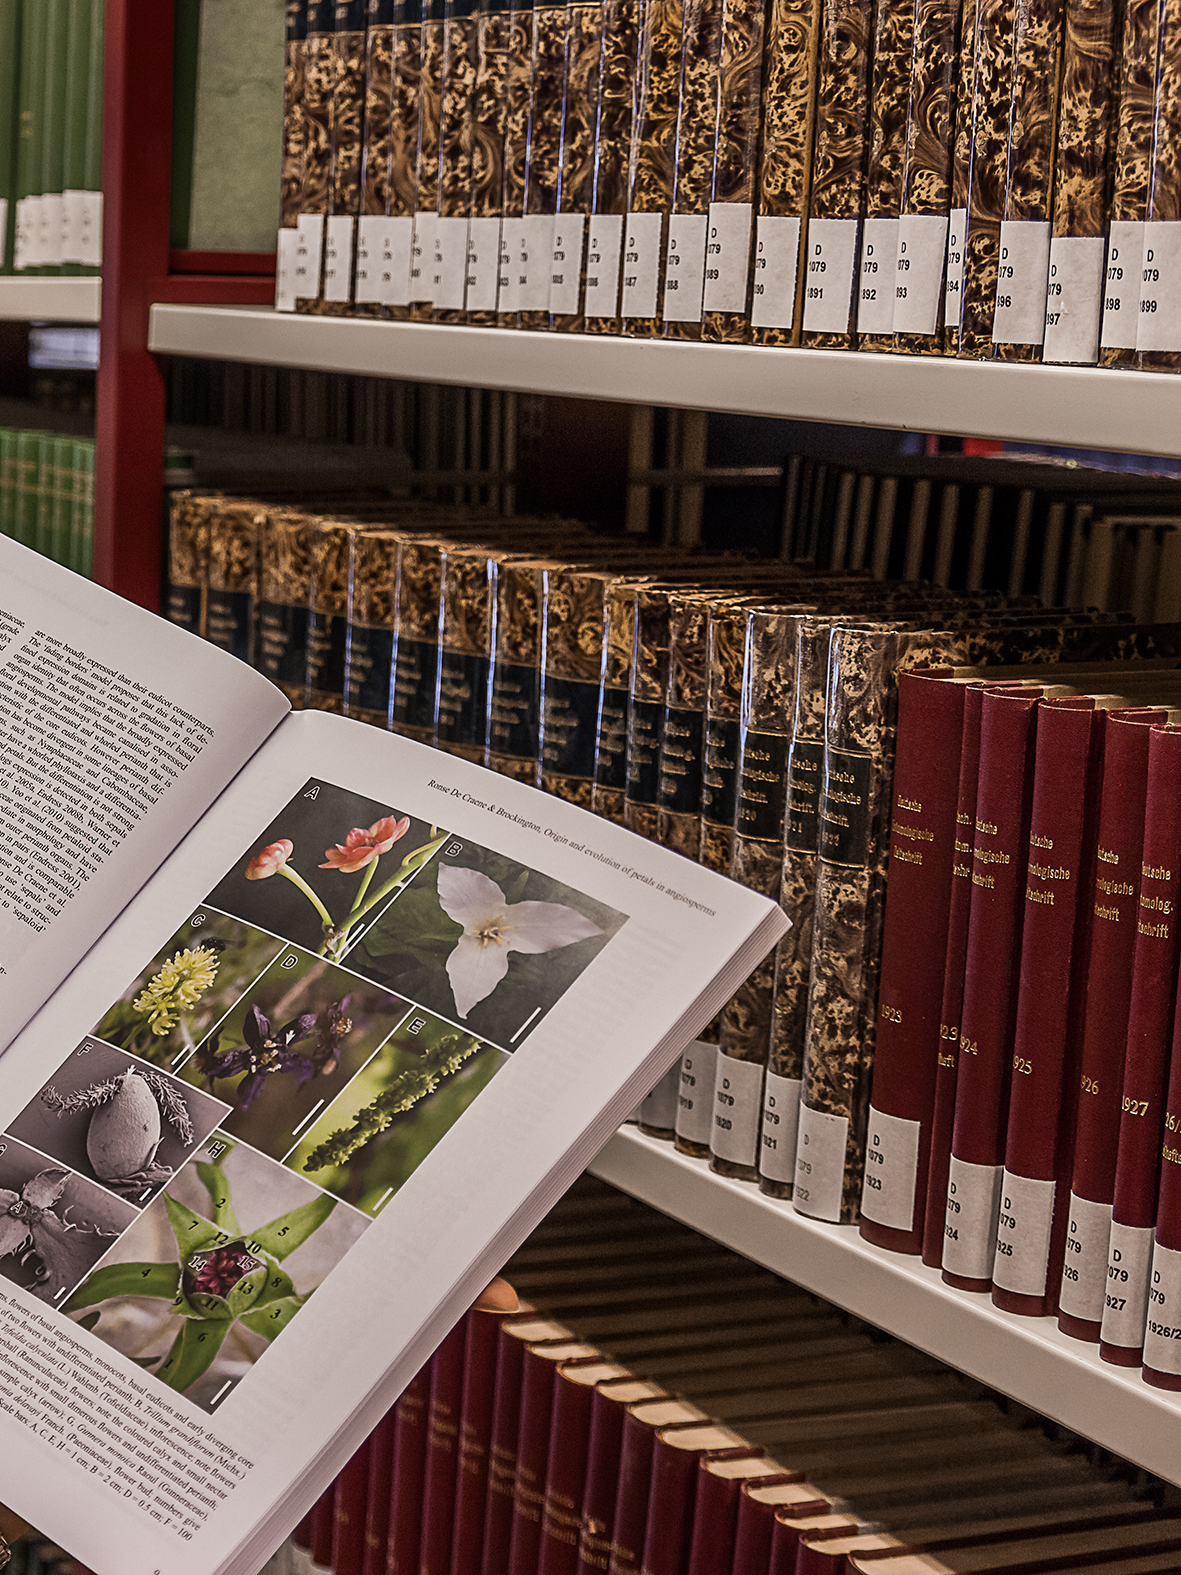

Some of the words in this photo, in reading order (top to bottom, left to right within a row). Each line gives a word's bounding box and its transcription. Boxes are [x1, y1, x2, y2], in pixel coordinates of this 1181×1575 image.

[711, 227, 718, 238] D
[950, 235, 957, 246] D
[814, 245, 822, 256] D
[866, 245, 874, 256] D
[901, 242, 907, 254] D
[1001, 248, 1009, 260] D
[1111, 248, 1119, 261] D
[1146, 249, 1155, 262] D
[1050, 264, 1057, 277] D
[861, 289, 877, 300] 892
[34, 629, 46, 638] are
[44, 635, 62, 647] more
[61, 643, 87, 661] broadly
[86, 658, 118, 677] expressed
[116, 673, 132, 686] than
[131, 681, 148, 694] their
[147, 691, 173, 708] eudicot
[303, 784, 322, 801] A
[426, 778, 451, 793] Ronse
[448, 787, 463, 800] De
[458, 792, 488, 809] Craene
[486, 803, 497, 813] &
[494, 806, 541, 834] Brockington,
[543, 827, 568, 844] Origin
[567, 840, 586, 852] and
[583, 848, 621, 870] evolution
[620, 866, 634, 875] of
[628, 869, 655, 886] petals
[654, 881, 665, 891] in
[664, 887, 716, 916] angiosperms
[444, 841, 464, 858] B
[189, 912, 207, 929] C
[280, 953, 299, 970] D
[406, 1016, 427, 1035] E
[76, 1042, 94, 1056] F
[959, 1034, 978, 1056] 924
[1012, 1054, 1033, 1075] 925
[722, 1078, 730, 1090] D
[769, 1096, 776, 1108] D
[1121, 1094, 1150, 1117] 1927
[873, 1135, 881, 1146] D
[207, 1141, 227, 1159] H
[950, 1182, 957, 1194] D
[10, 1201, 24, 1214] A
[215, 1198, 227, 1209] 2
[1004, 1197, 1012, 1209] D
[188, 1220, 200, 1231] 7
[277, 1226, 290, 1237] 5
[1070, 1220, 1077, 1233] D
[213, 1231, 230, 1245] 12
[246, 1241, 263, 1255] 10
[1113, 1249, 1122, 1262] D
[188, 1256, 207, 1272] 14
[237, 1255, 257, 1271] 15
[140, 1268, 153, 1278] 4
[1107, 1265, 1129, 1282] 079
[1153, 1270, 1161, 1284] D
[237, 1281, 255, 1296] 13
[271, 1277, 283, 1288] 8
[172, 1295, 183, 1307] 9
[204, 1299, 219, 1311] 11
[1104, 1293, 1127, 1311] 927
[269, 1309, 282, 1320] 3
[197, 1332, 209, 1343] 6
[164, 1359, 174, 1369] 1
[7, 1298, 31, 1317] flowers
[29, 1313, 41, 1321] of
[36, 1315, 56, 1332] basal
[52, 1329, 93, 1361] angiosperms,
[93, 1356, 126, 1384] monocots,
[127, 1377, 148, 1395] basal
[144, 1392, 174, 1414] eudicots
[172, 1411, 189, 1424] and
[186, 1420, 206, 1436] early
[204, 1432, 238, 1460] diverging
